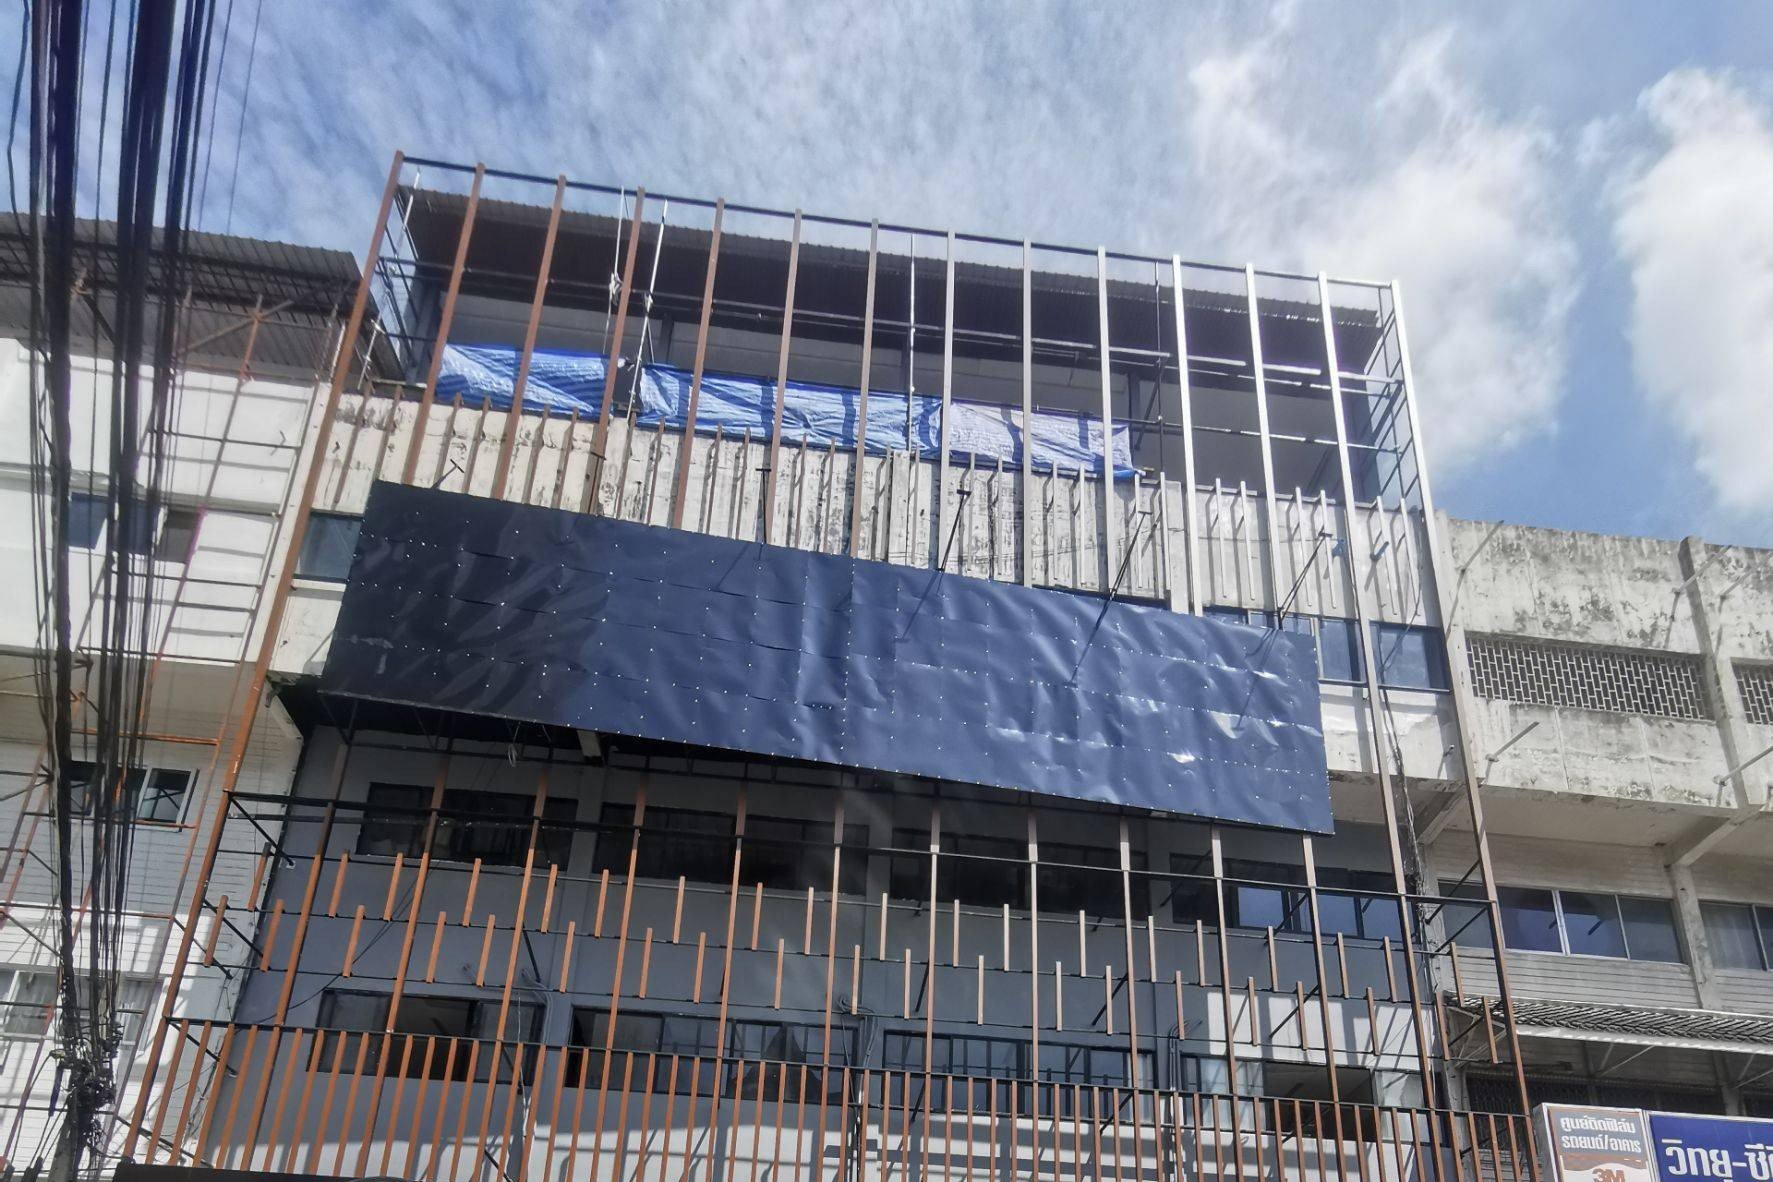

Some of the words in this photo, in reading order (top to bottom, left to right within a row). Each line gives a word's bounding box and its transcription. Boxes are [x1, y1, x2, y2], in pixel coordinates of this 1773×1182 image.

[1560, 1115, 1636, 1134] ศูนย์ติดฟิล์ม
